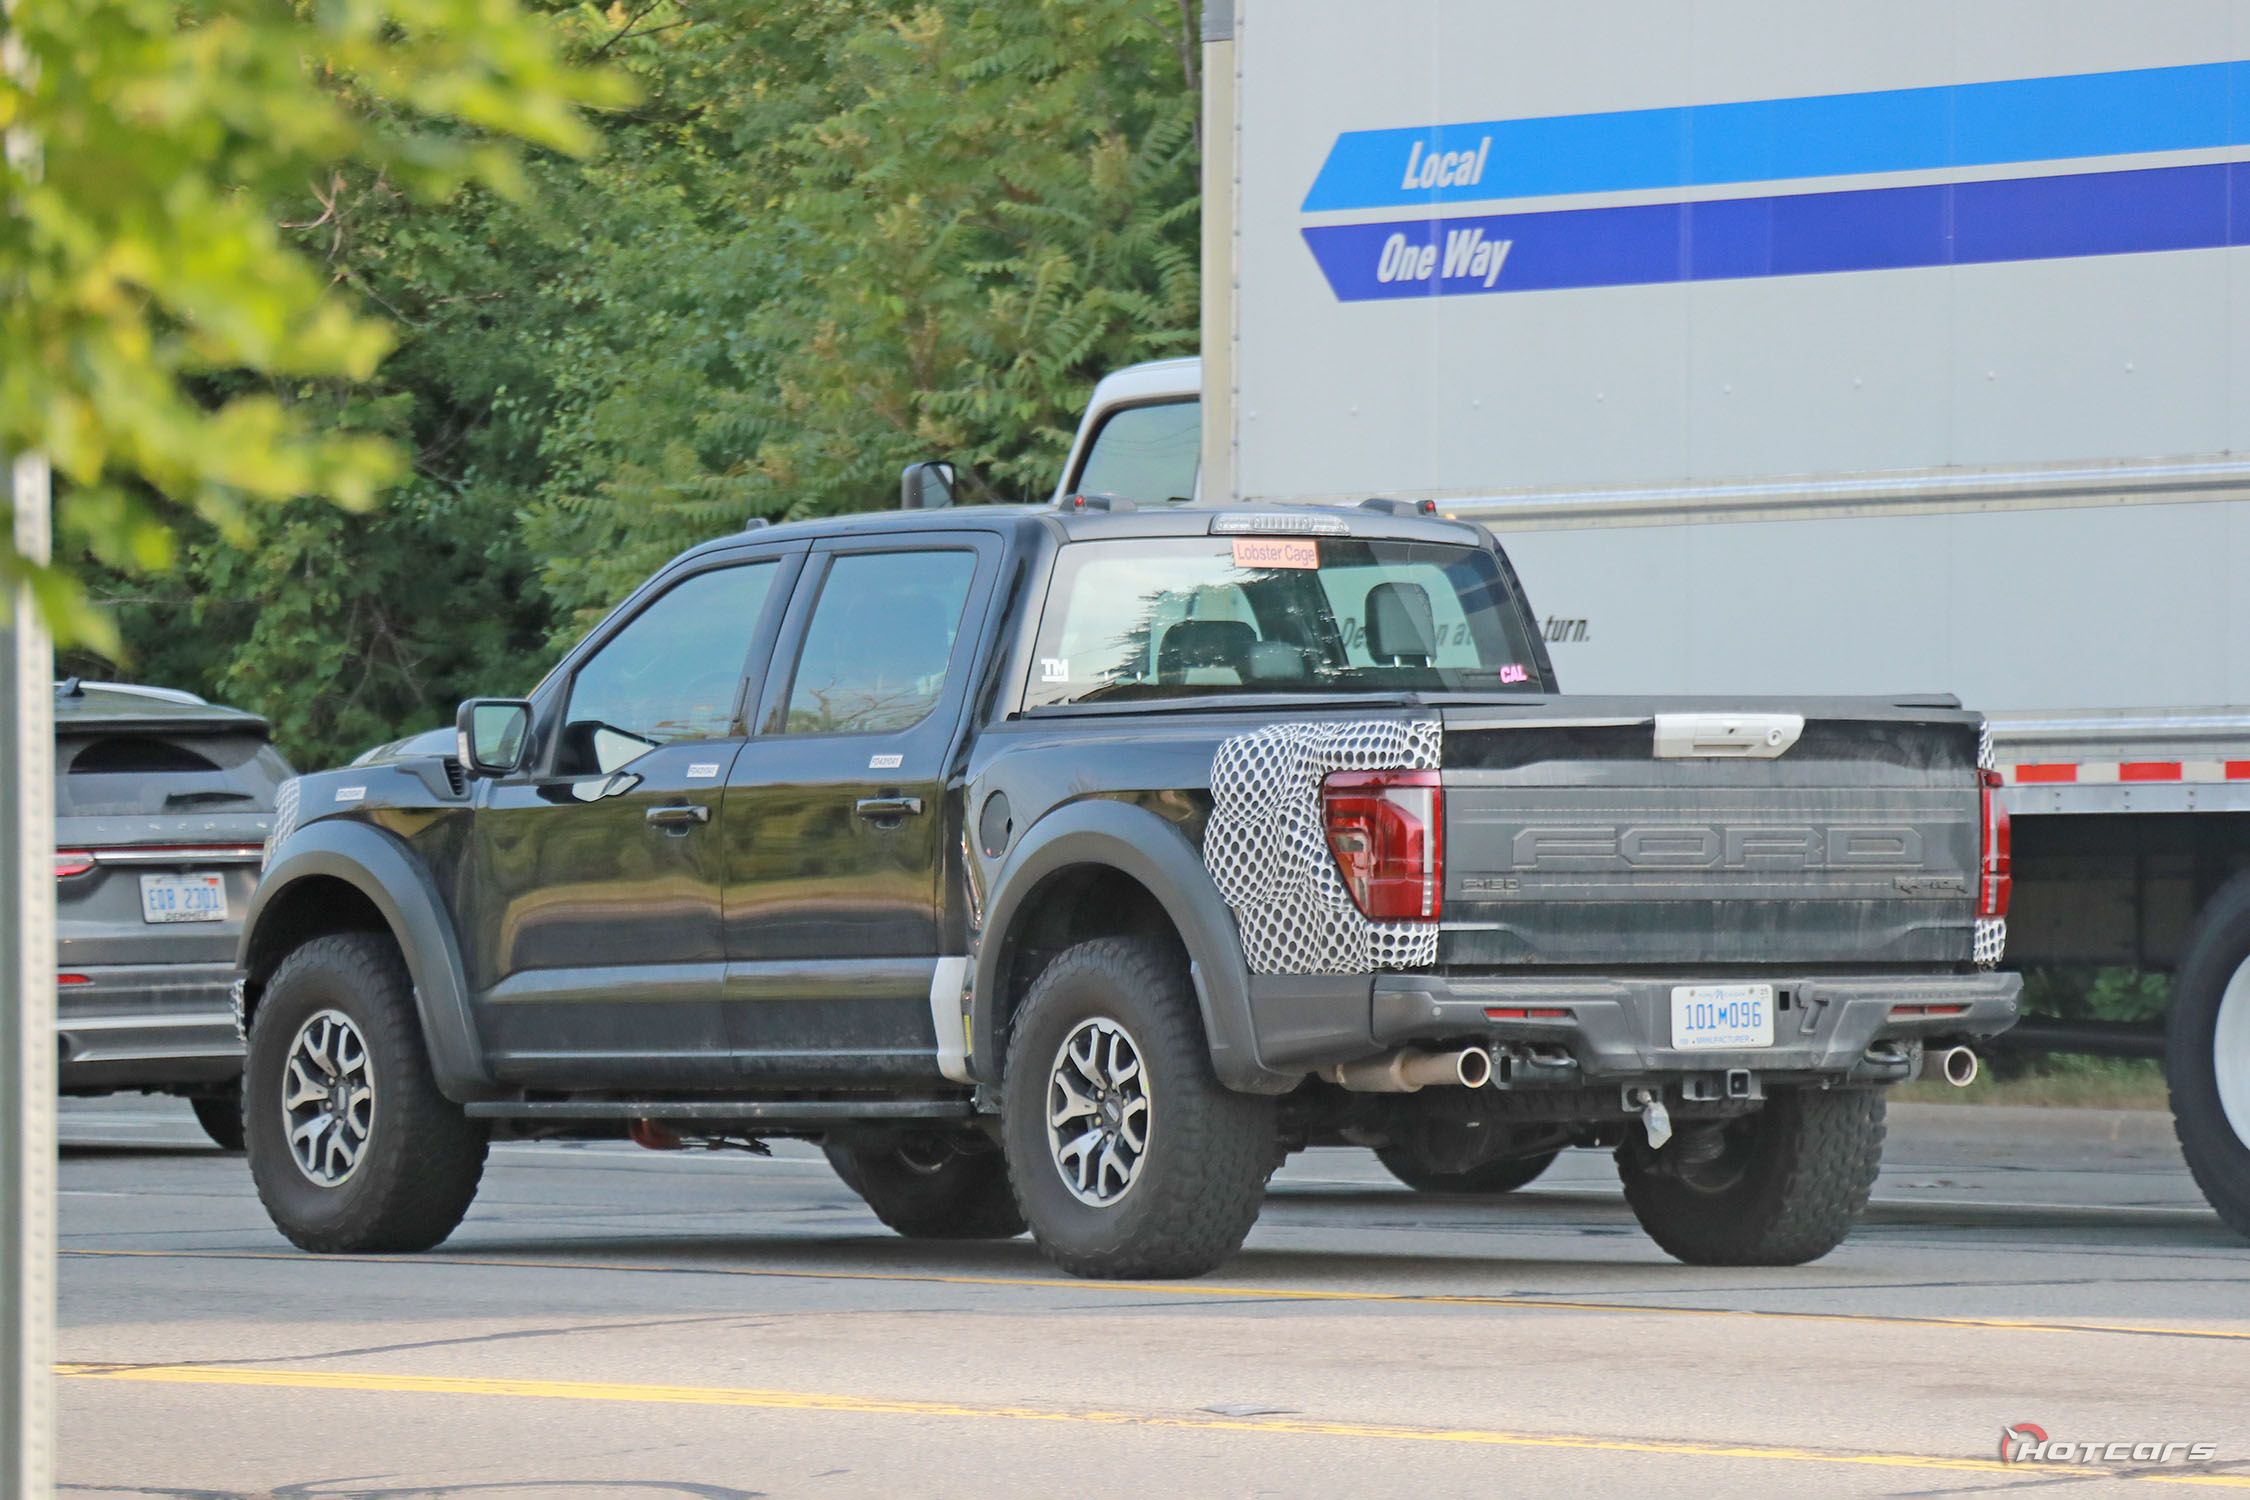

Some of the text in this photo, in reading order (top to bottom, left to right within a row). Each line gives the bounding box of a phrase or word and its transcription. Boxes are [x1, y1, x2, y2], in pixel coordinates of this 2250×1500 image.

[1401, 136, 1493, 190] Local
[1376, 228, 1514, 288] One Way
[1236, 544, 1315, 567] Lobster Cage
[1500, 664, 1528, 684] CAL
[1512, 826, 1924, 869] FORD
[1685, 1001, 1762, 1030] 101M096
